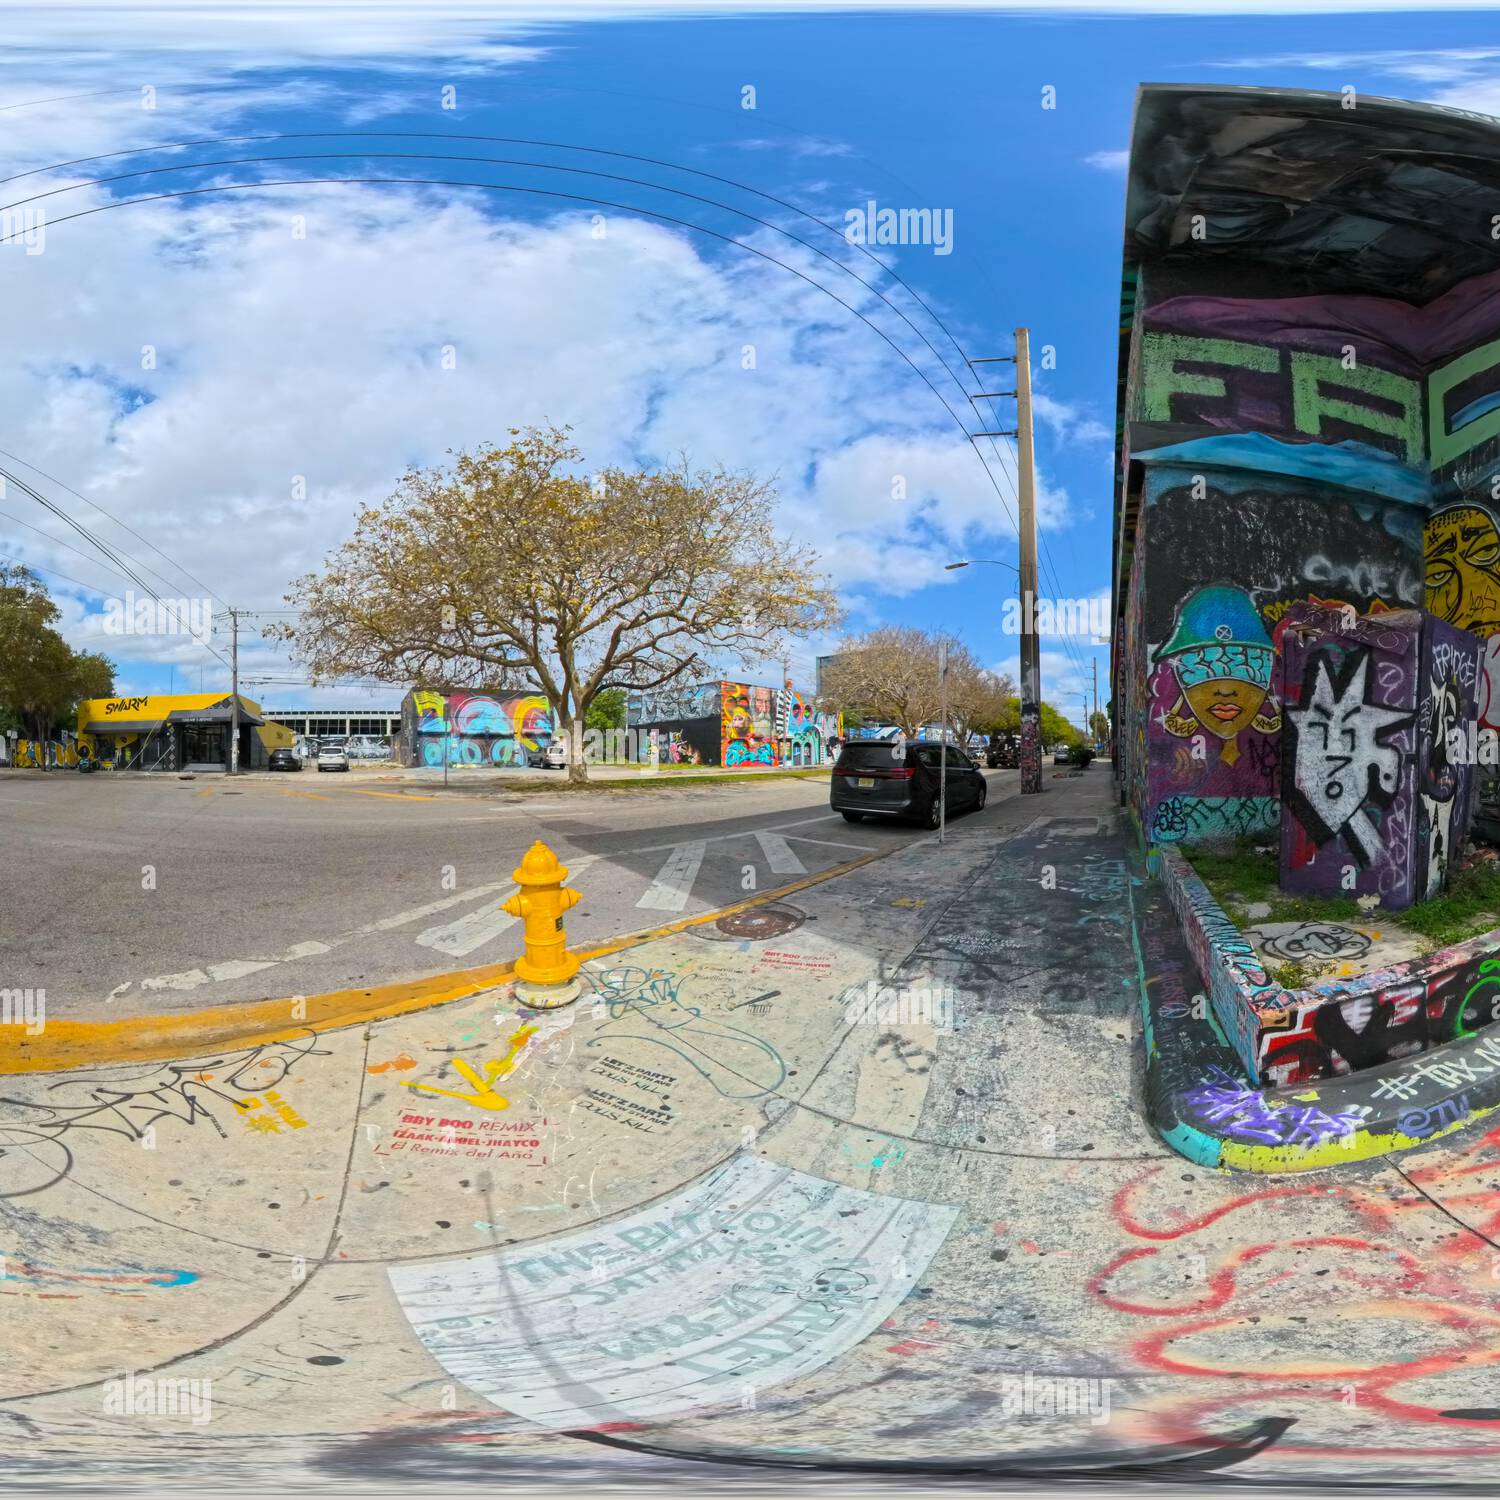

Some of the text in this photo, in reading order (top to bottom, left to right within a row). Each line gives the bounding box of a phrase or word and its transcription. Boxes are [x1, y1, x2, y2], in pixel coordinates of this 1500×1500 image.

[105, 696, 149, 715] SWARM
[628, 1102, 676, 1122] PARTY
[402, 1114, 538, 1133] BBY BOO REMIX
[390, 1141, 407, 1151] El
[409, 1142, 460, 1157] Remix
[464, 1147, 492, 1159] del
[509, 1242, 627, 1287] THE
[617, 1210, 845, 1254] BITCOIN
